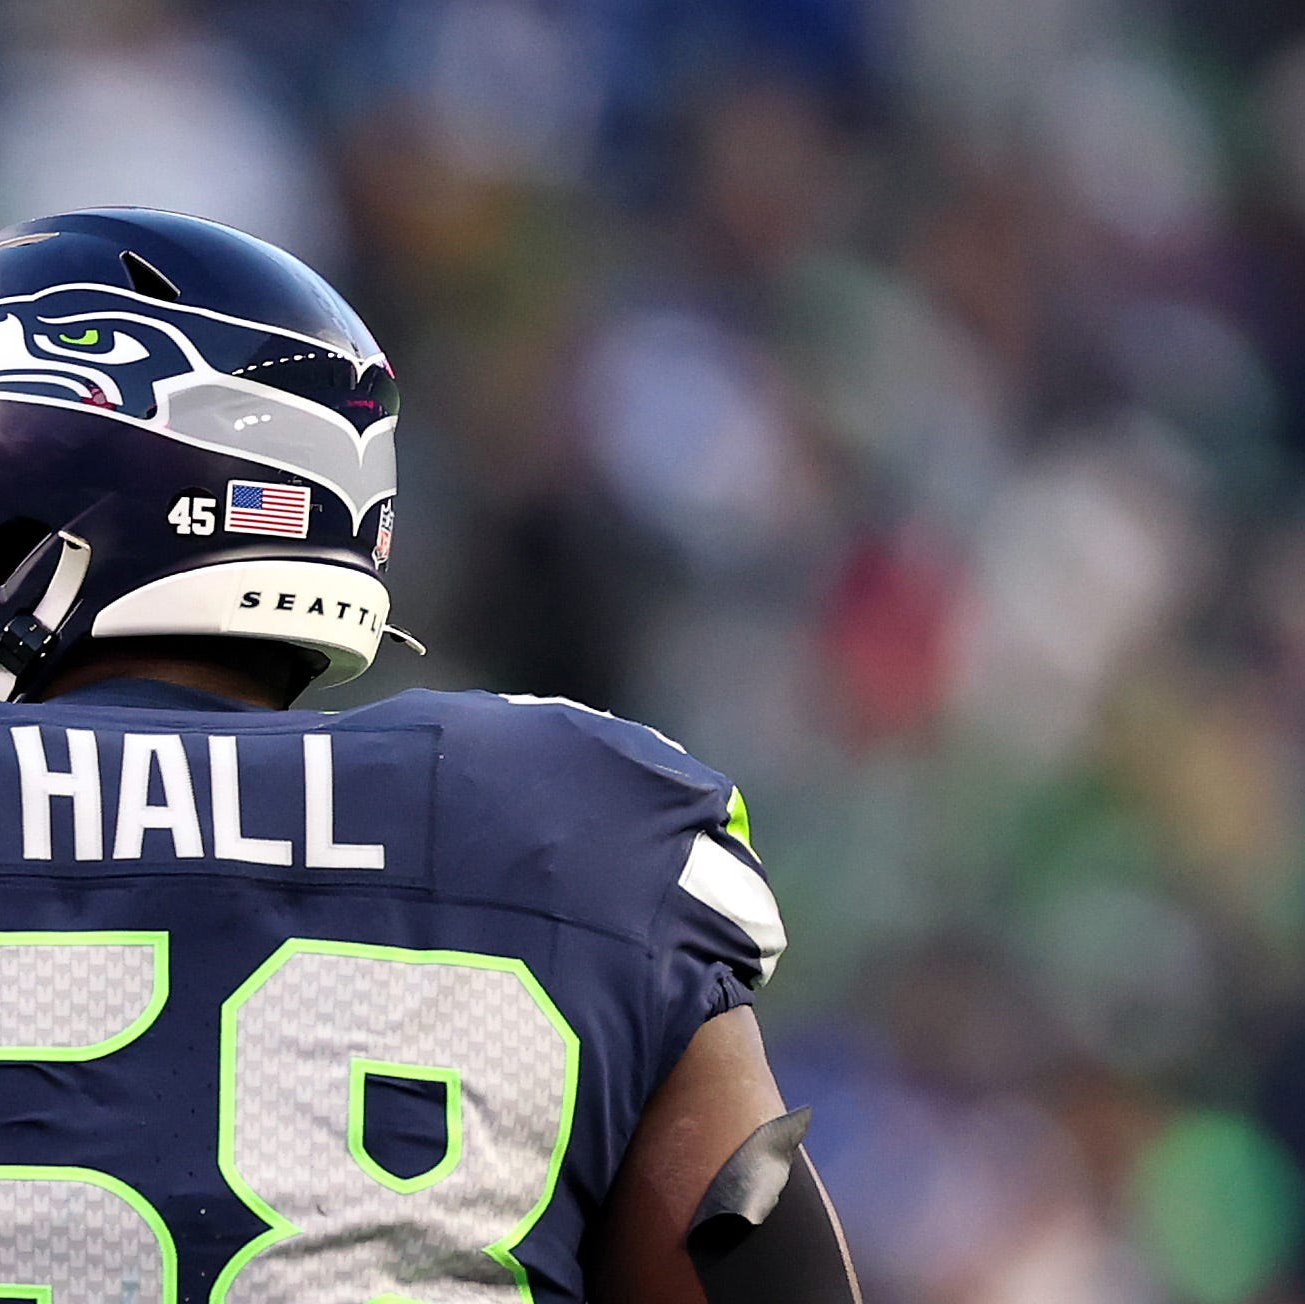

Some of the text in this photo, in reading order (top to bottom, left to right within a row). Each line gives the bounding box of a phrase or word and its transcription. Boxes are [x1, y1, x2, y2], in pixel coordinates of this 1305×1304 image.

[167, 496, 216, 535] 45
[239, 591, 381, 636] SEATTL
[10, 726, 385, 869] HALL
